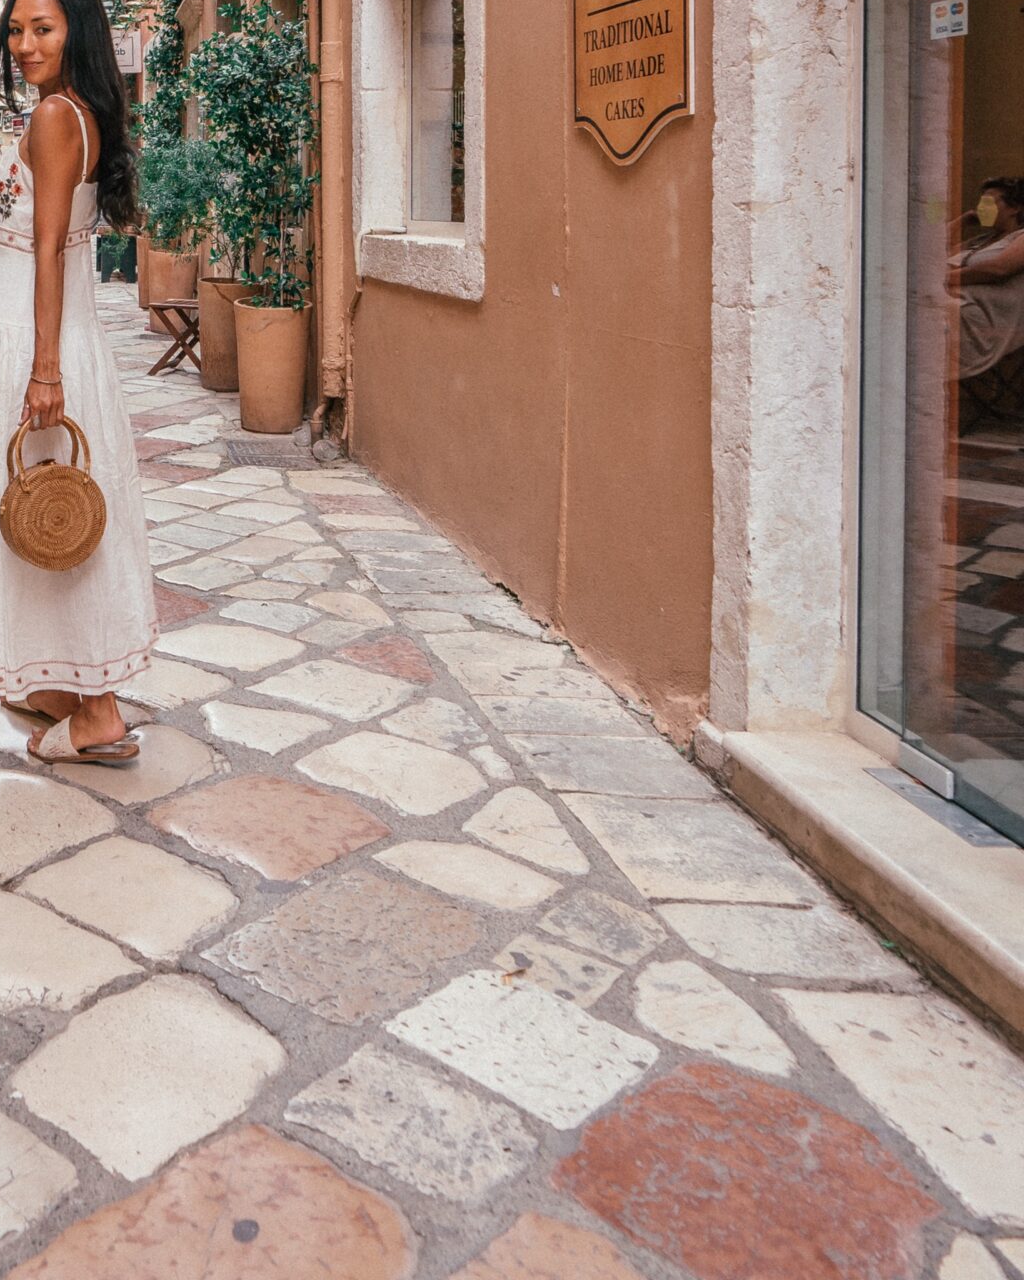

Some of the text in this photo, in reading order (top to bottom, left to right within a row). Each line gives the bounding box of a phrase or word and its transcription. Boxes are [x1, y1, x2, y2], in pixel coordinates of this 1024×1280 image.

[584, 9, 673, 54] TRADITIONAL
[589, 53, 665, 87] HOME MADE
[605, 97, 645, 122] CAKES
